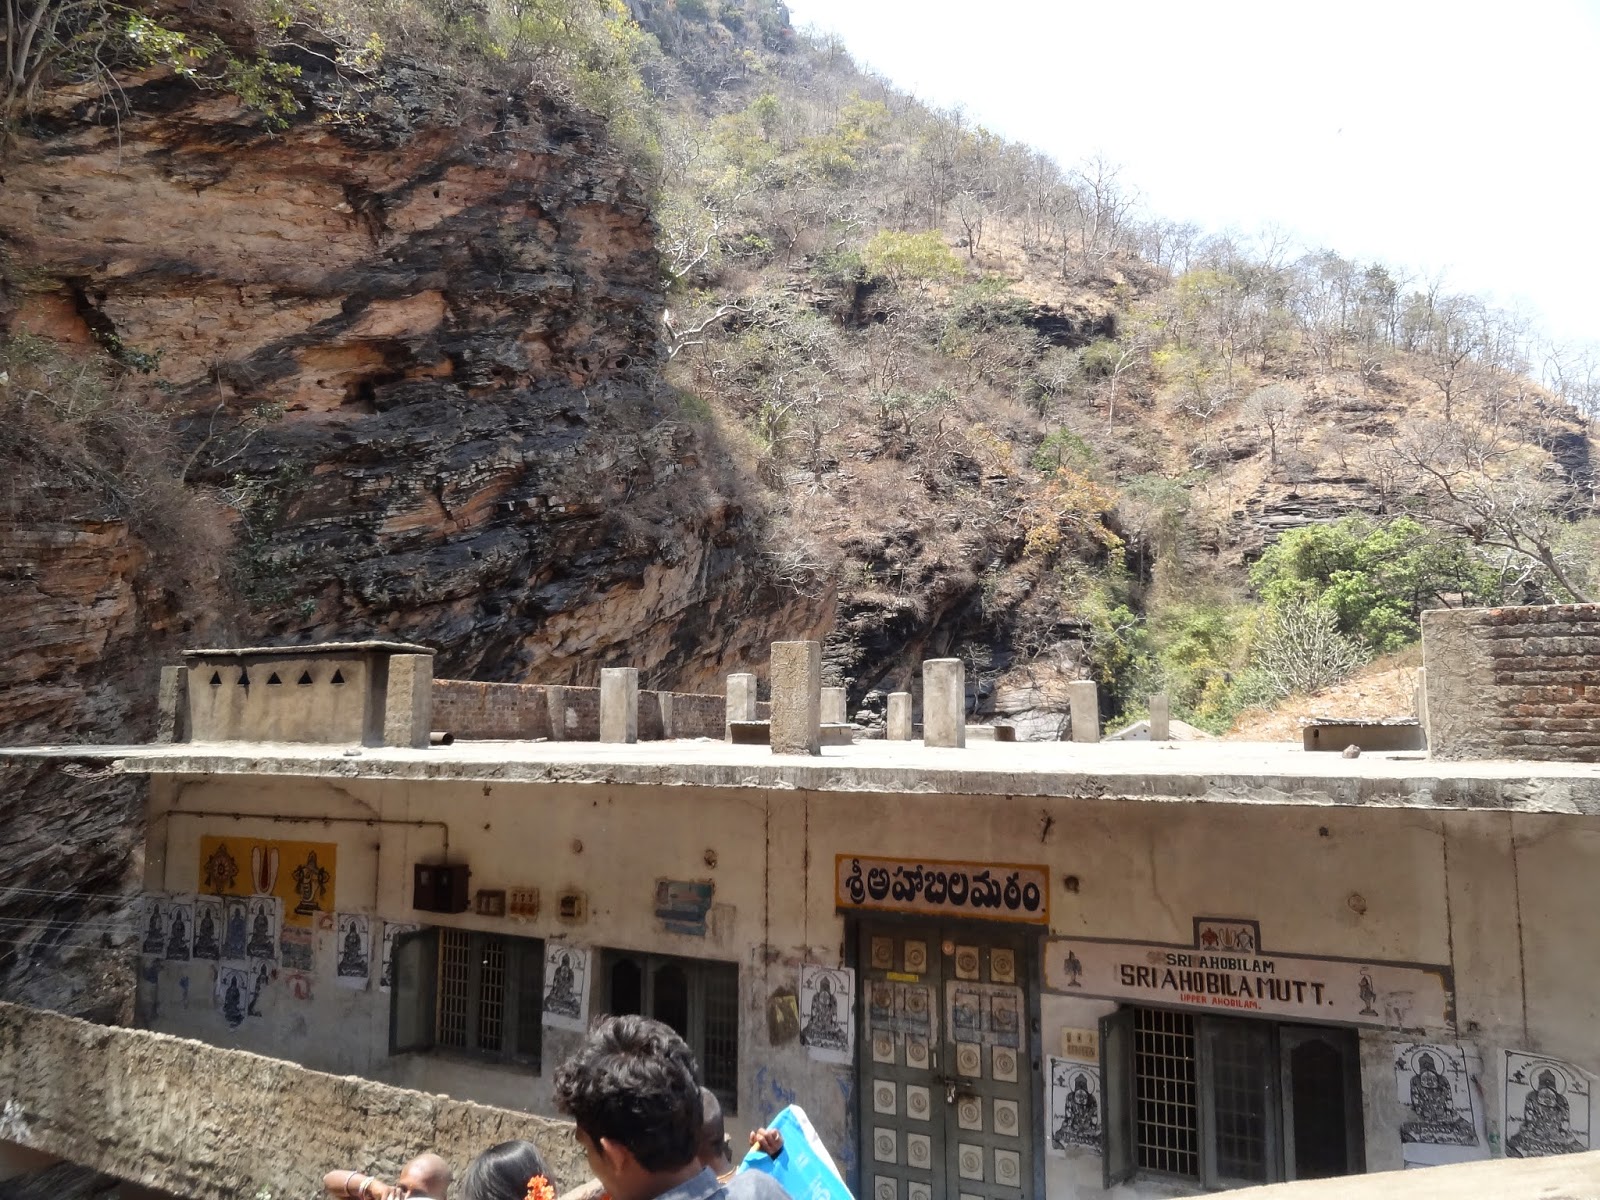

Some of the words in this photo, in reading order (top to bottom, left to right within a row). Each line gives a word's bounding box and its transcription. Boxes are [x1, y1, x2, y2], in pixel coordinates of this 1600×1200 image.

[1166, 953, 1192, 967] SRI
[1200, 956, 1275, 974] AHOBILAM
[1120, 964, 1157, 988] SRI
[1161, 970, 1252, 998] AHOBILA
[1257, 977, 1334, 1006] MUTT.
[1180, 993, 1207, 1004] UPPER
